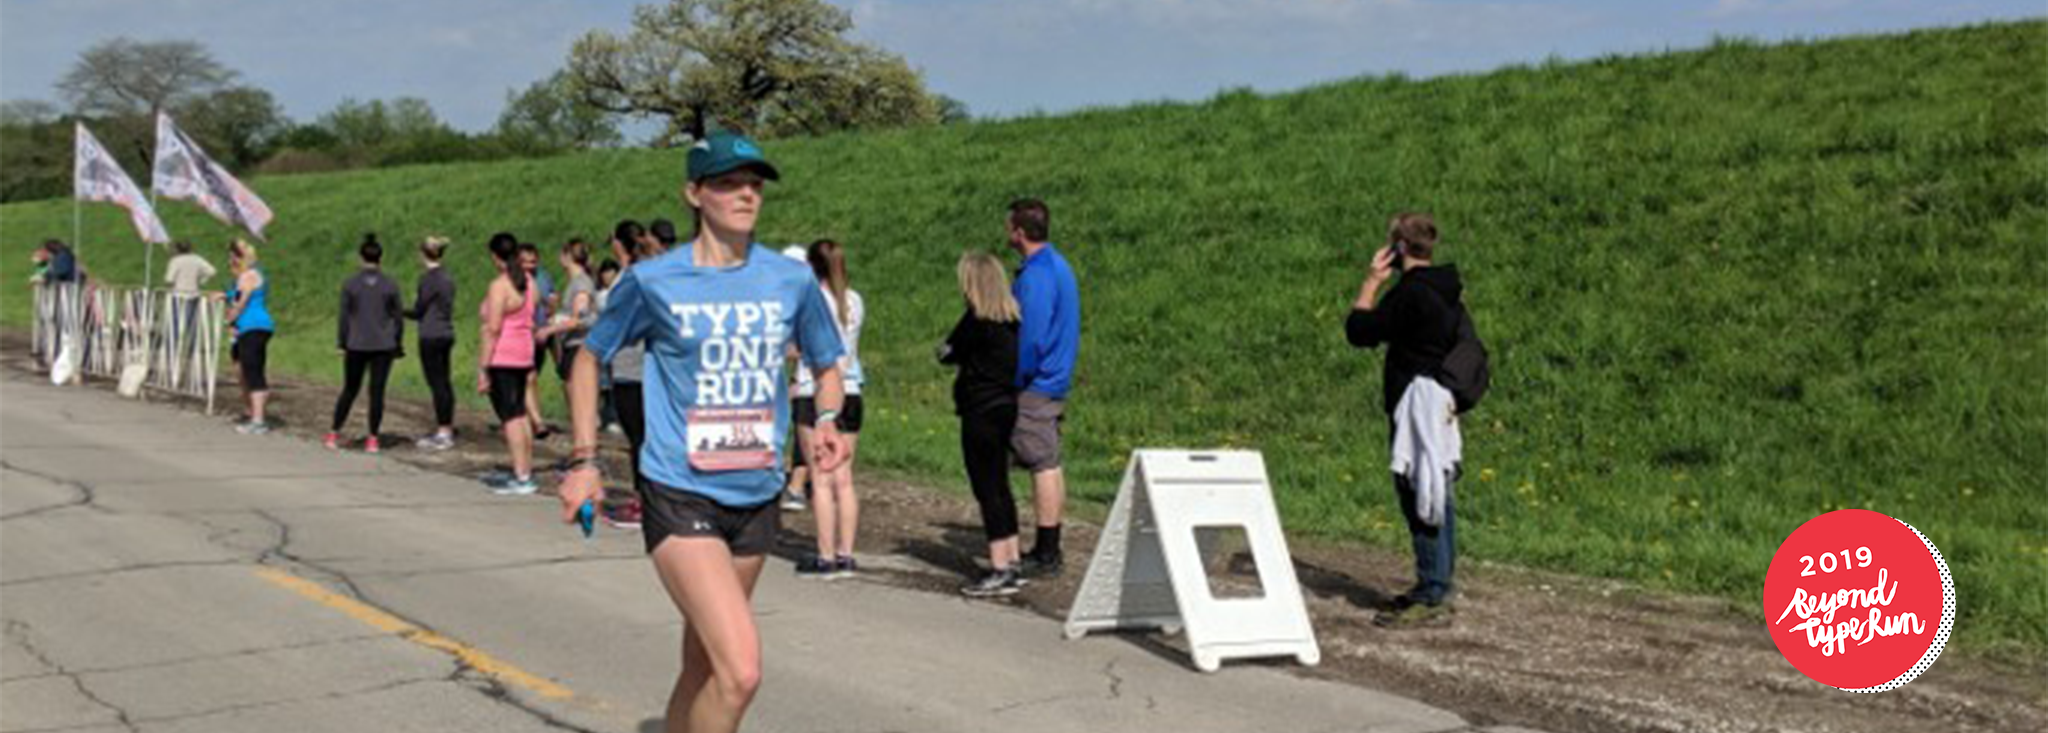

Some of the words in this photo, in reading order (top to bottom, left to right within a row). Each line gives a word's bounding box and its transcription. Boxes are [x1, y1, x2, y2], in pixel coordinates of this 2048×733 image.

[671, 301, 784, 337] TYPE
[701, 336, 784, 370] ONE
[695, 369, 779, 404] RUN
